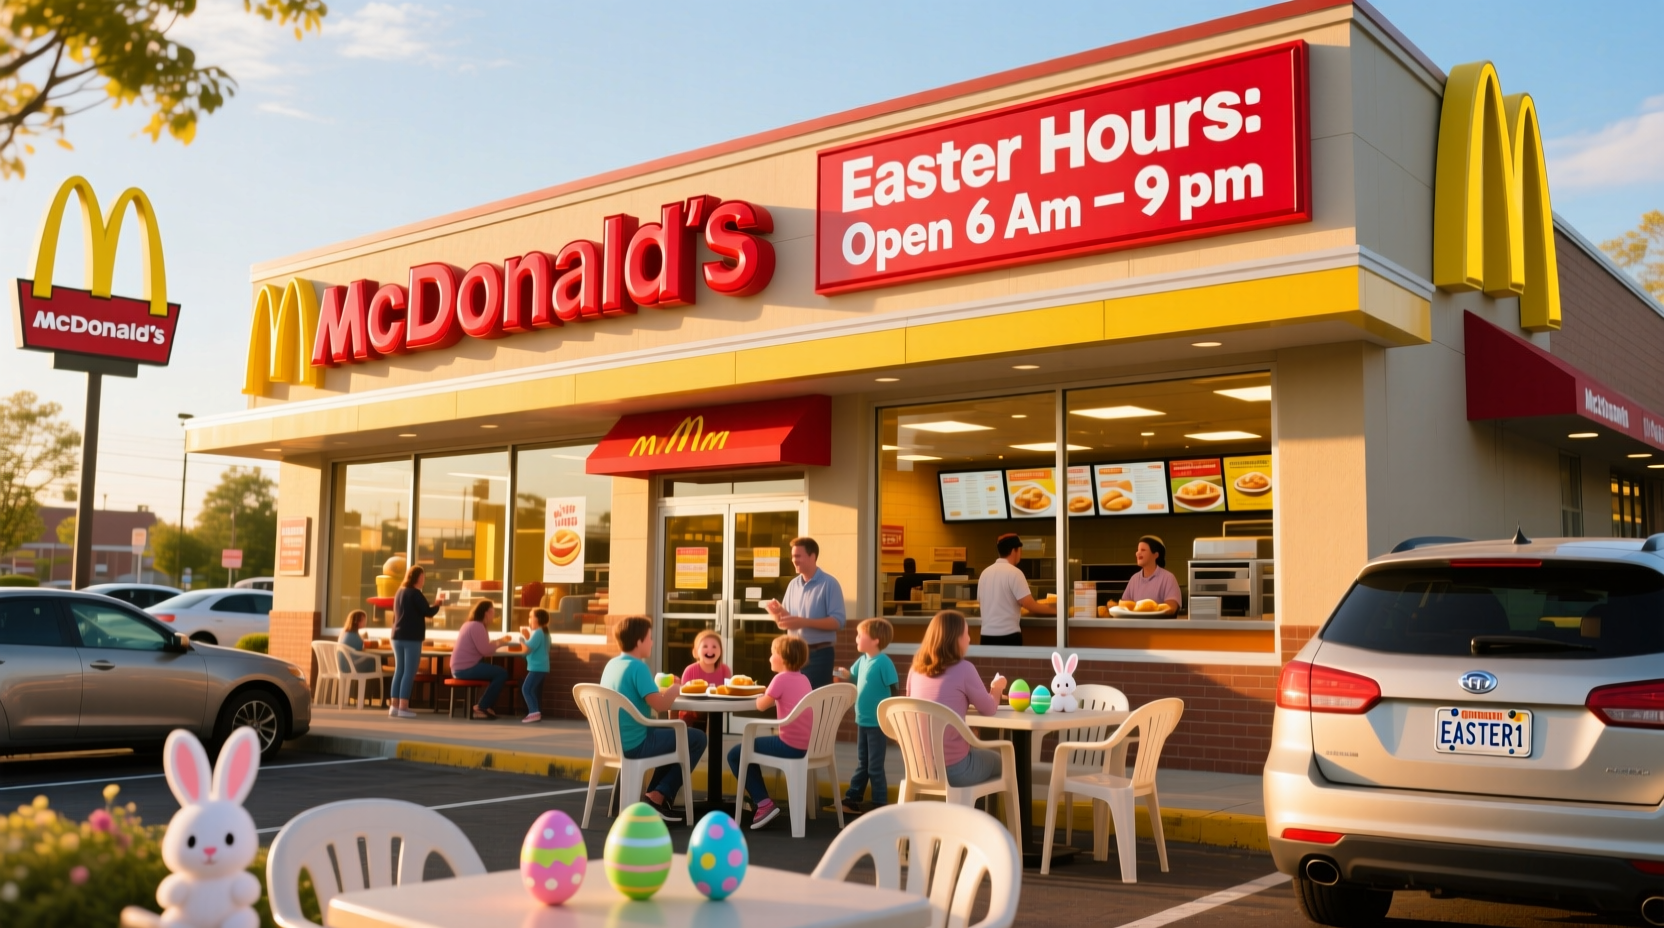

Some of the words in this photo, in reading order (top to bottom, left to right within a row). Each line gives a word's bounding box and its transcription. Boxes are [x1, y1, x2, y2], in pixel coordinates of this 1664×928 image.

[841, 135, 1022, 213] Easter
[1039, 87, 1262, 175] Hours:
[841, 220, 953, 272] Open
[965, 197, 995, 245] 6
[1003, 192, 1082, 240] Am
[1133, 164, 1170, 217] 9
[1179, 162, 1264, 221] pm
[32, 309, 165, 345] McDonald's
[310, 194, 776, 369] McDonald's
[1440, 720, 1523, 748] EASTER1
